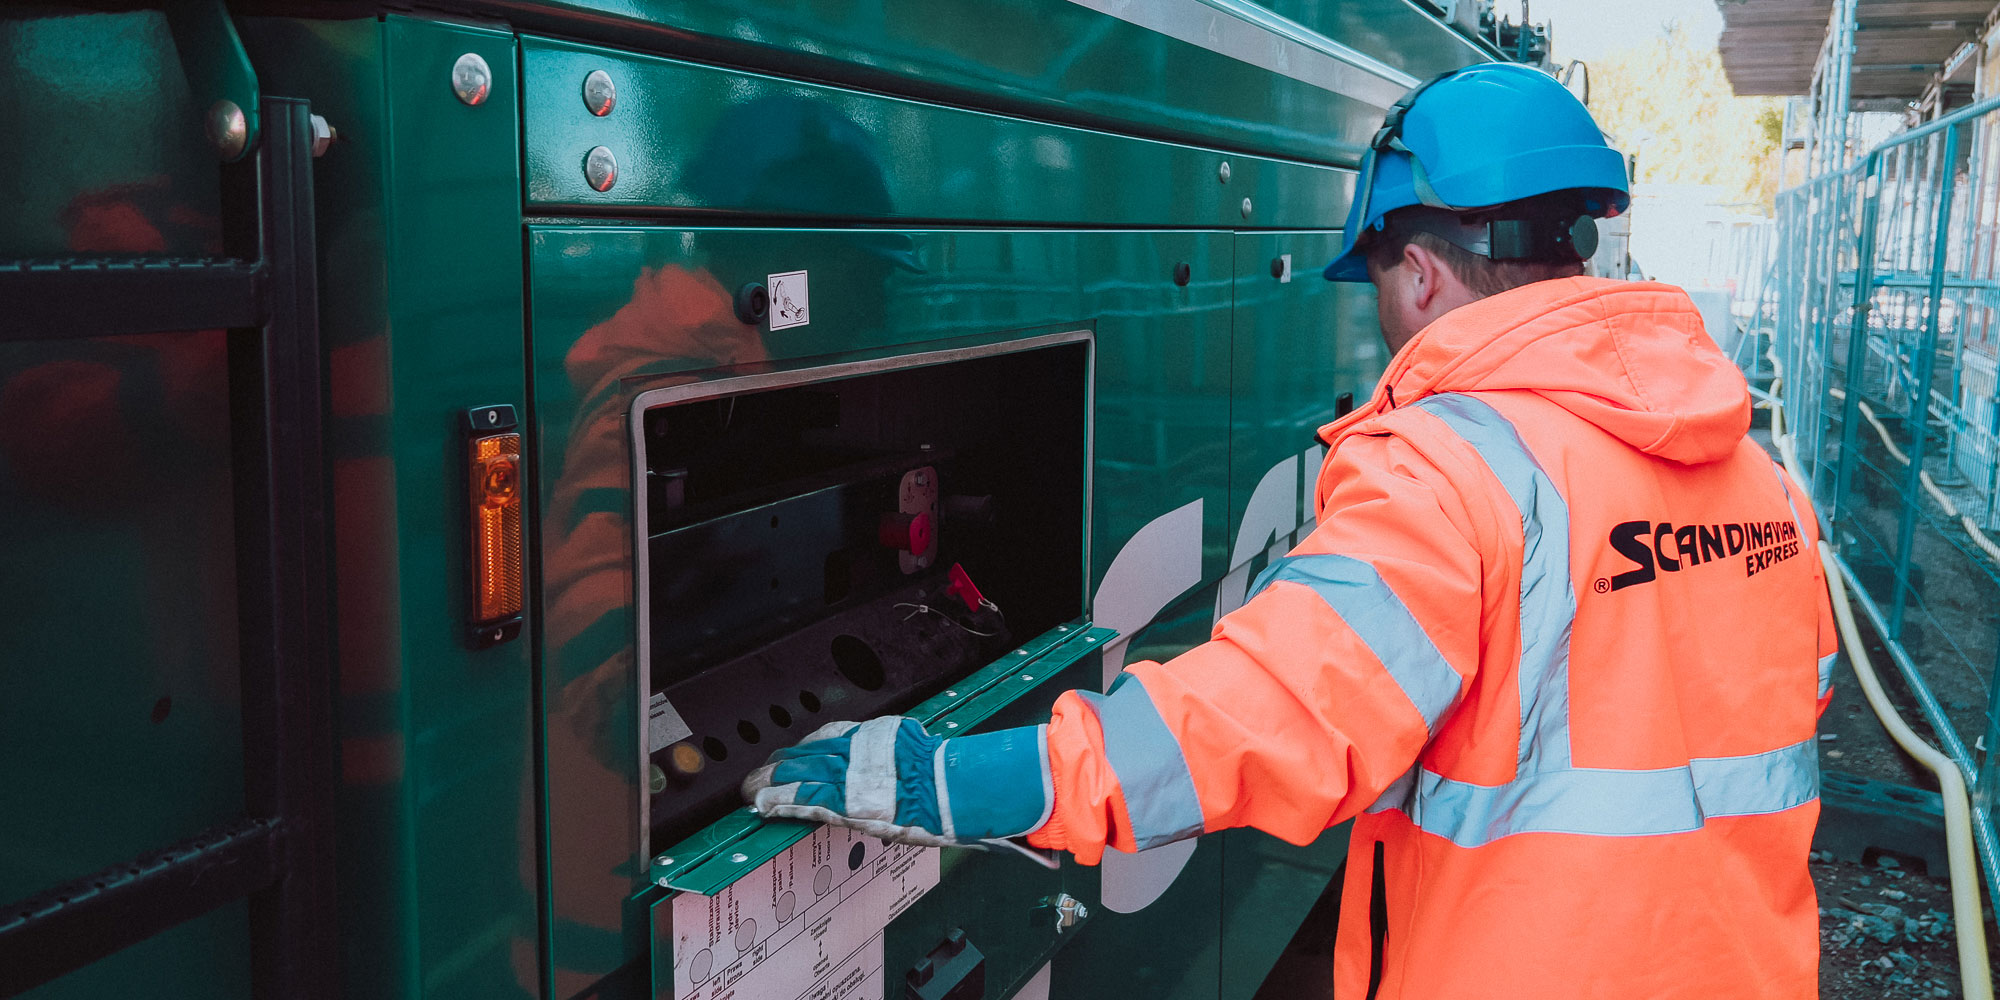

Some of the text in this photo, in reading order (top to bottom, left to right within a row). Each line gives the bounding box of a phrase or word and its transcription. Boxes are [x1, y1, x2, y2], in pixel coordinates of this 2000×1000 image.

[1609, 521, 1797, 592] SCANDINAVIAN
[1745, 541, 1799, 577] EXPRESS
[752, 955, 763, 966] side
[727, 962, 743, 976] Prawa
[727, 970, 743, 985] strona
